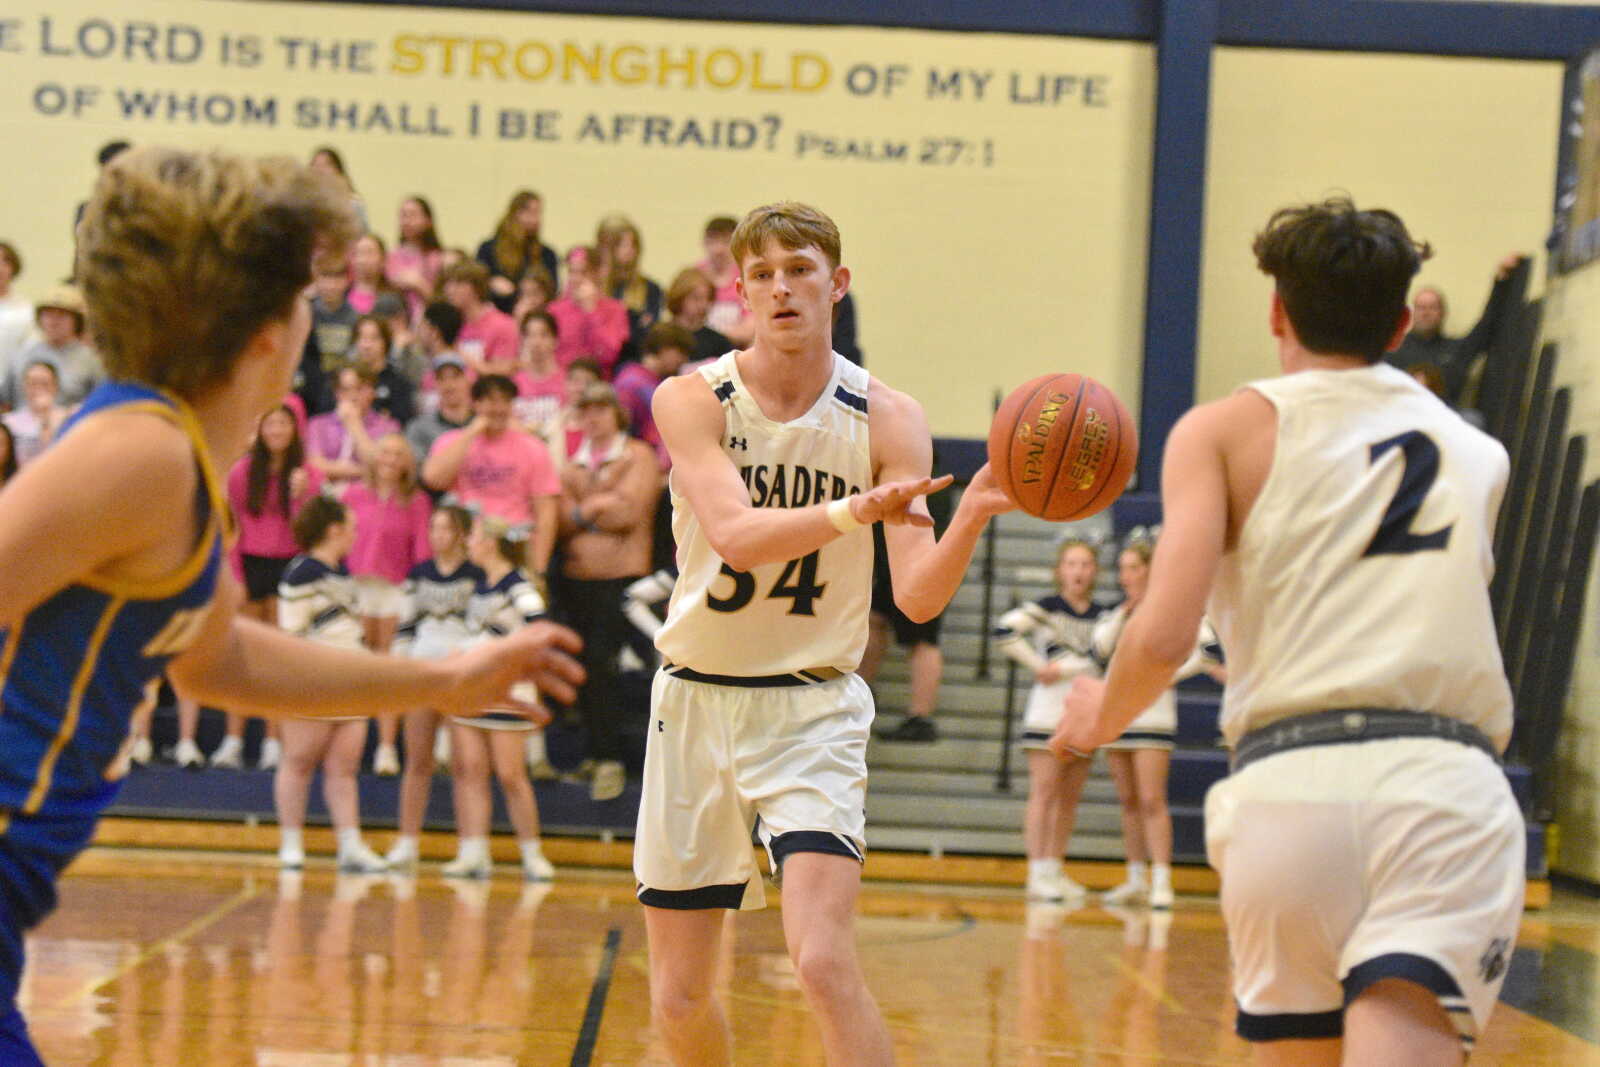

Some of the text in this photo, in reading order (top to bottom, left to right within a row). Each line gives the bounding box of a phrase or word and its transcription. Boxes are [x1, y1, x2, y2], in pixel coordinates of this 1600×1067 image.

[40, 17, 203, 64] LORD
[220, 35, 263, 68] IS
[278, 38, 375, 74] THE
[391, 33, 831, 94] STRONGHOLD
[845, 64, 911, 97] OF
[927, 69, 993, 101] MY
[1009, 73, 1109, 108] LIFE
[33, 83, 101, 117] OF
[116, 89, 278, 127] WHOM
[294, 98, 452, 137] SHALL
[469, 105, 481, 138] I
[497, 110, 561, 142] BE
[578, 114, 782, 151] AFRAID?
[918, 138, 995, 168] 27:1
[1362, 430, 1454, 556] 2
